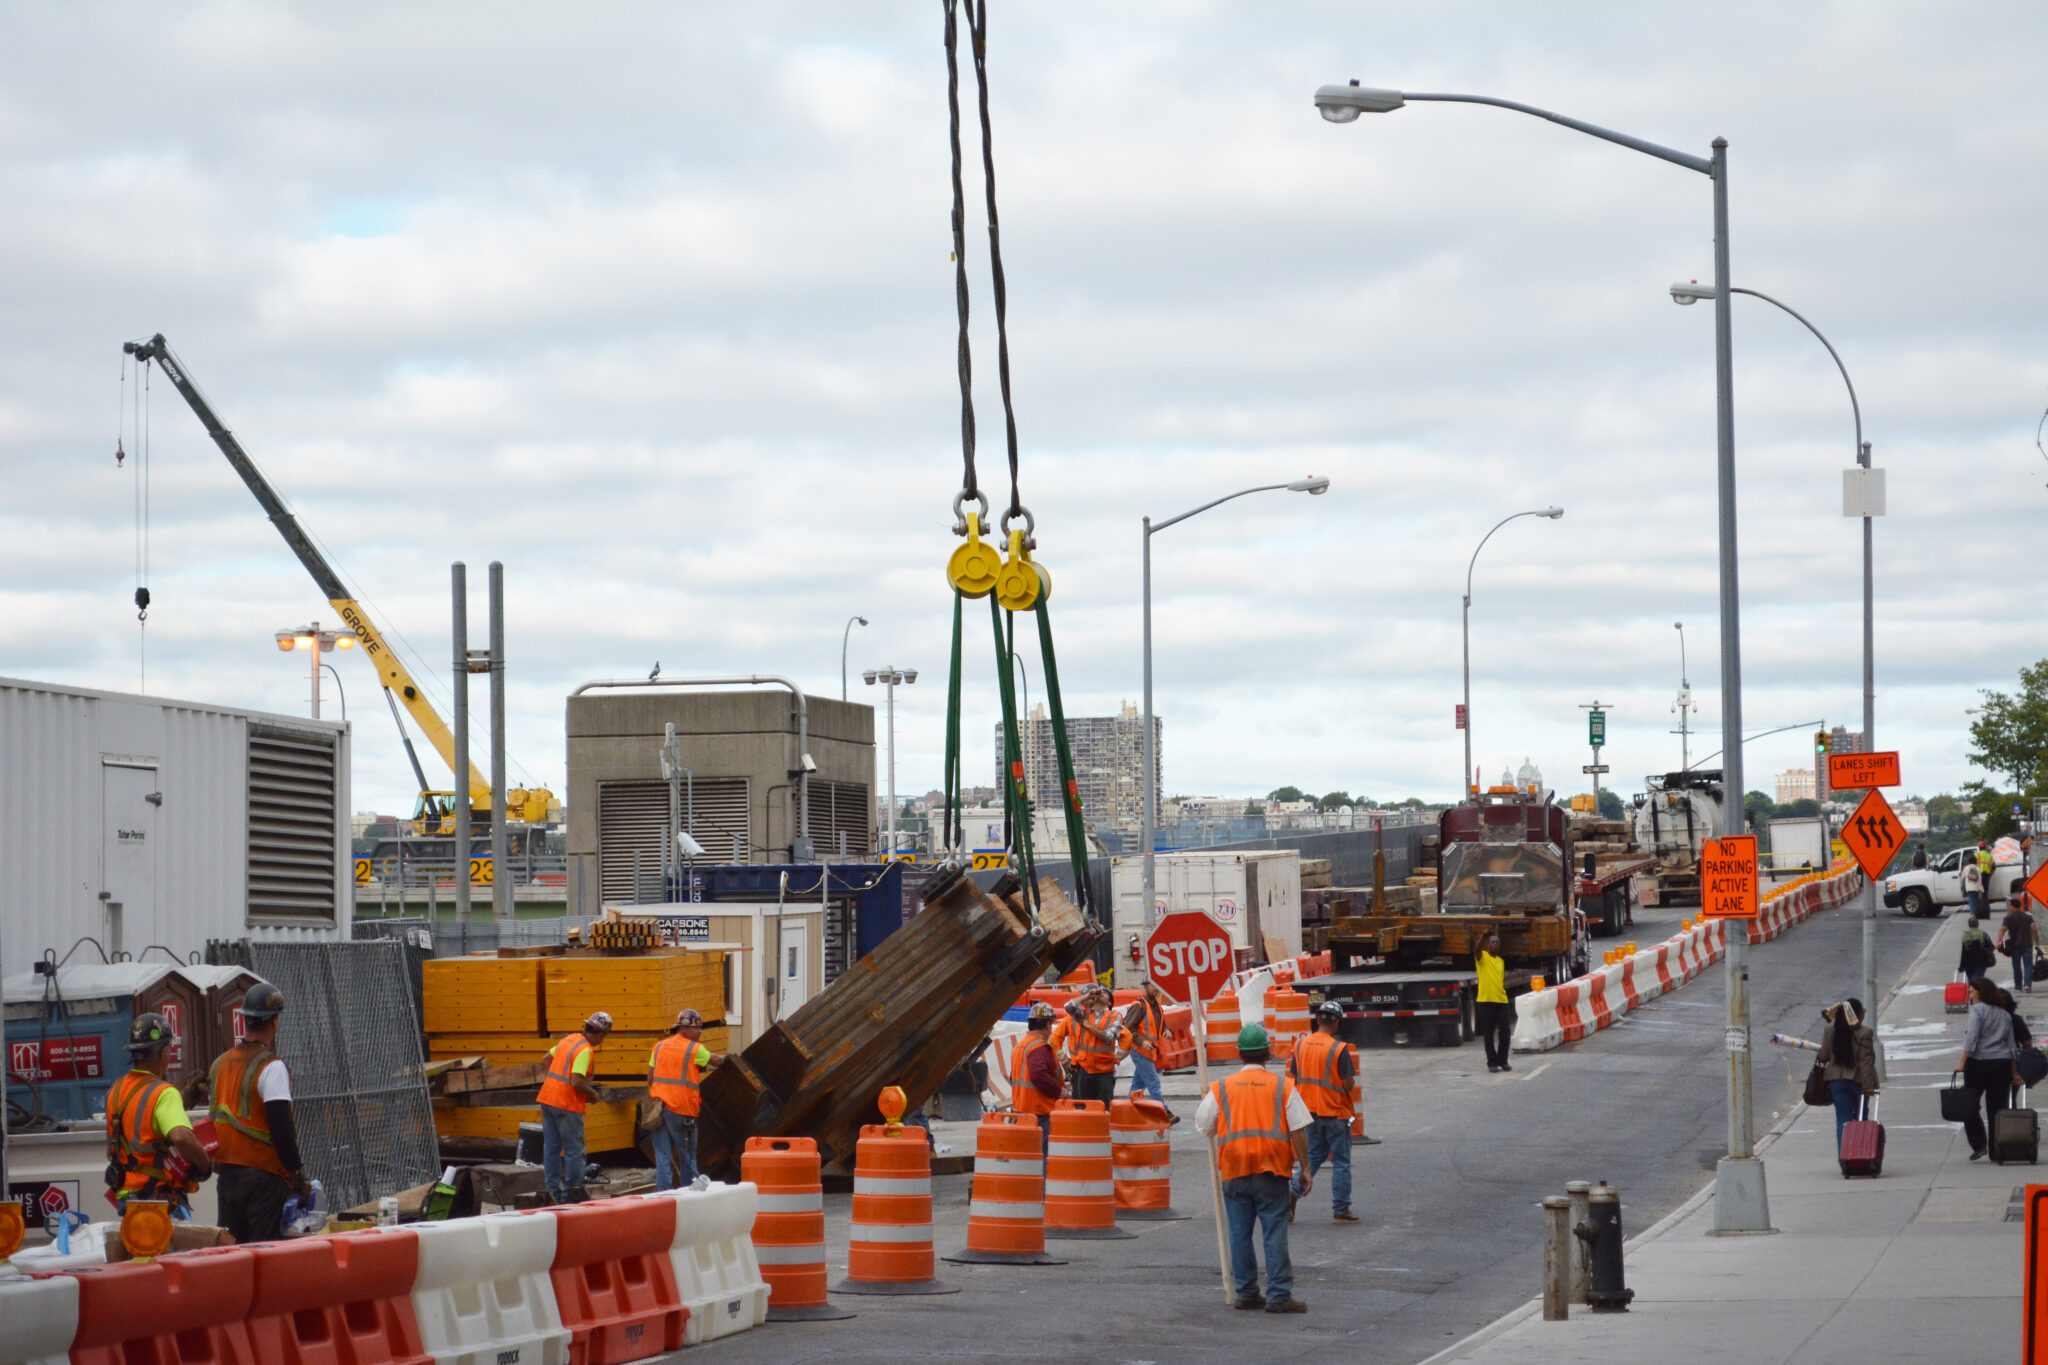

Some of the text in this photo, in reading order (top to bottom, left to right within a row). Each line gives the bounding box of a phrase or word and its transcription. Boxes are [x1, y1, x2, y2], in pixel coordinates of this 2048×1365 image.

[162, 358, 182, 384] GROVE
[342, 607, 380, 656] GROVE
[1834, 757, 1893, 771] LANES SHIFT
[1853, 771, 1876, 783] LEFT
[1720, 842, 1736, 857] NO
[1706, 859, 1753, 875] PARKING
[1711, 878, 1749, 893] ACTIVE
[1218, 904, 1235, 915] 731
[1715, 896, 1745, 911] LANE
[1152, 938, 1228, 977] STOP
[50, 1044, 97, 1055] 800-68-8955
